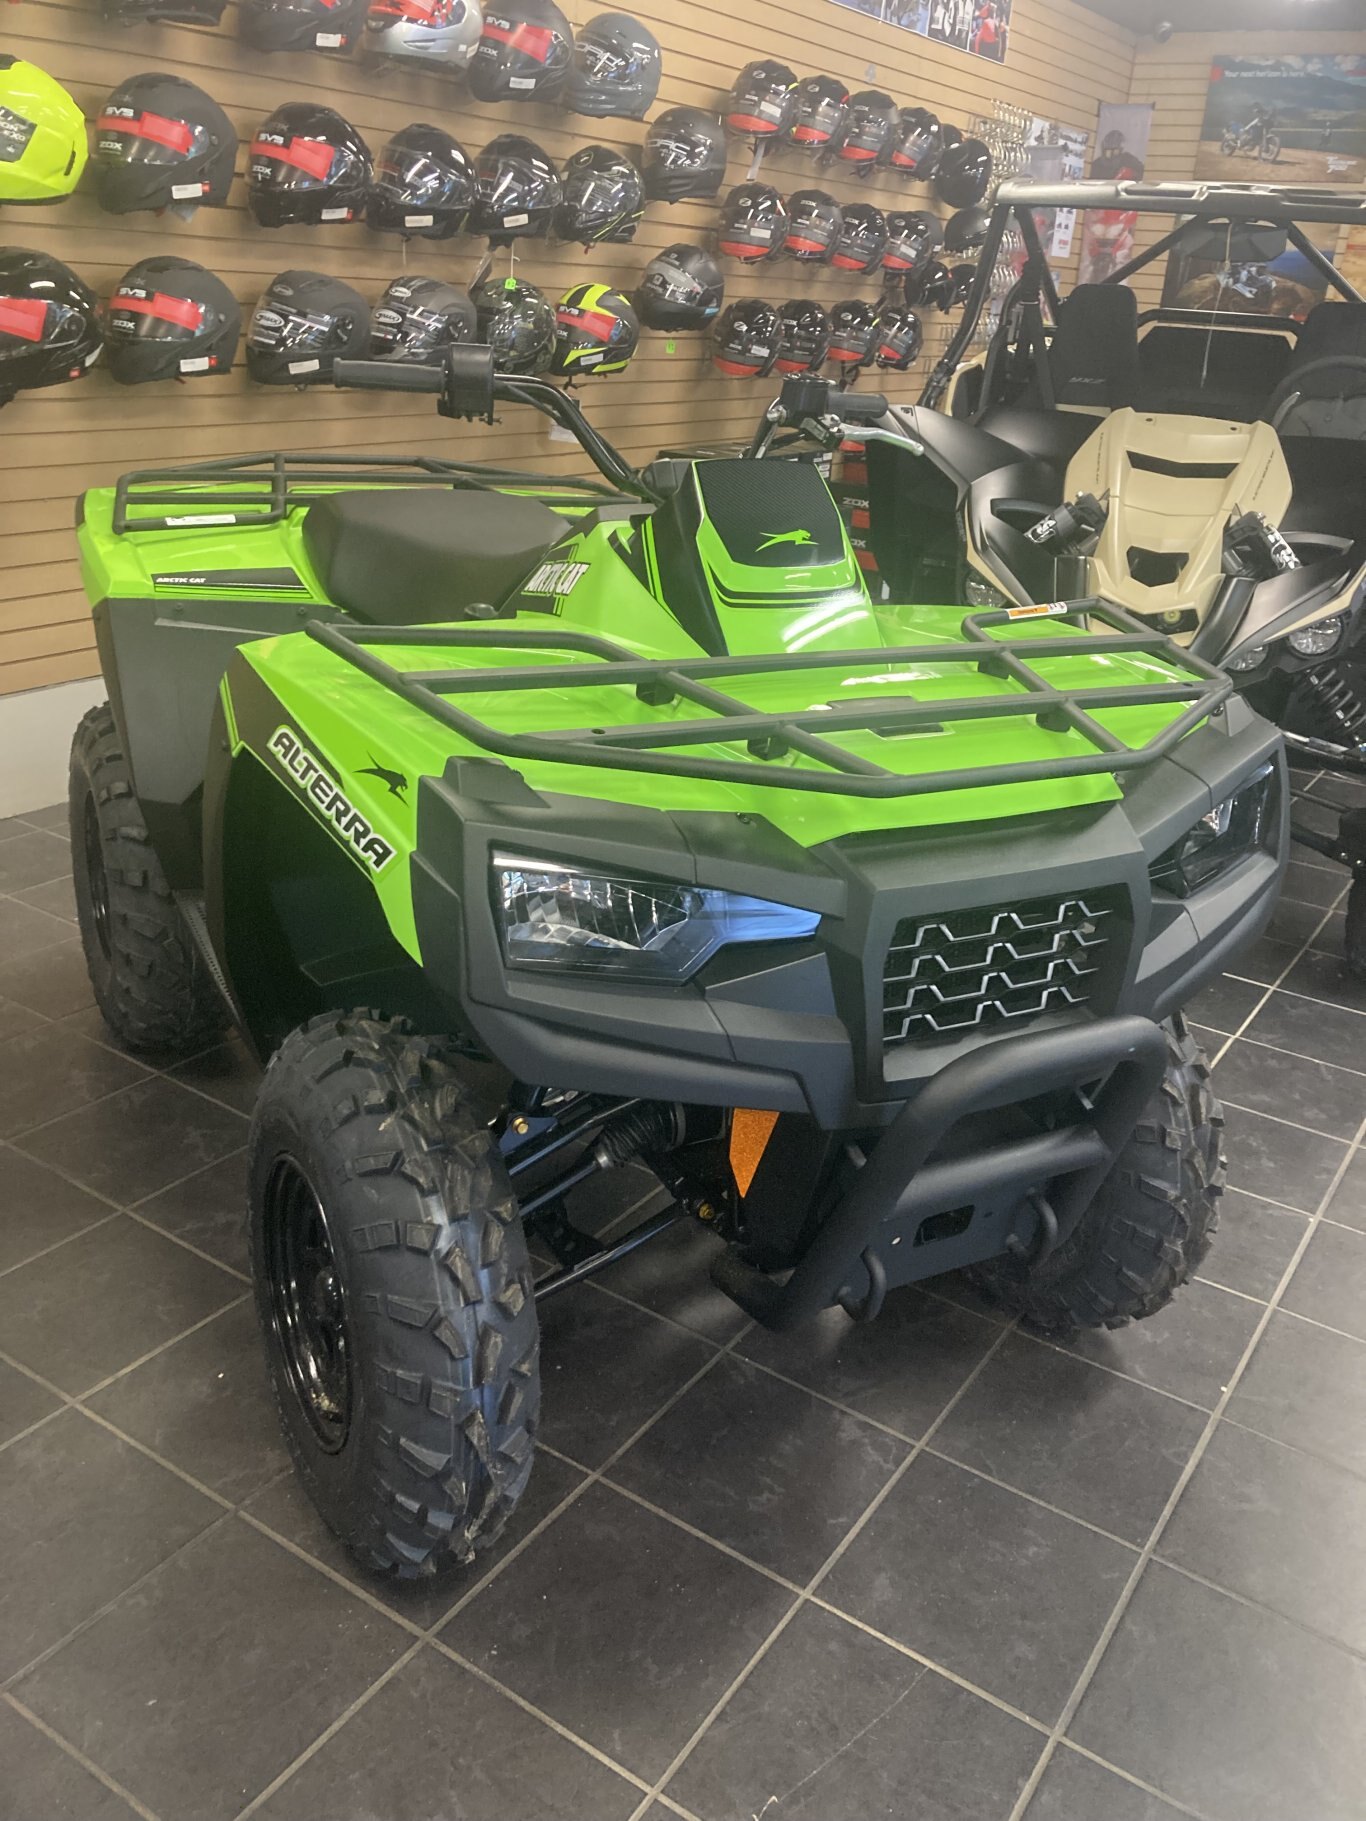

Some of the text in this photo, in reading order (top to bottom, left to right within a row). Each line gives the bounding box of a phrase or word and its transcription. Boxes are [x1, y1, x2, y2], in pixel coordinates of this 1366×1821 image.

[98, 141, 123, 151] ZOX
[252, 164, 273, 175] ZOX
[111, 319, 136, 330] ZOX
[842, 497, 870, 509] ZOX
[850, 538, 867, 549] OX
[270, 729, 396, 871] ALTERRA
